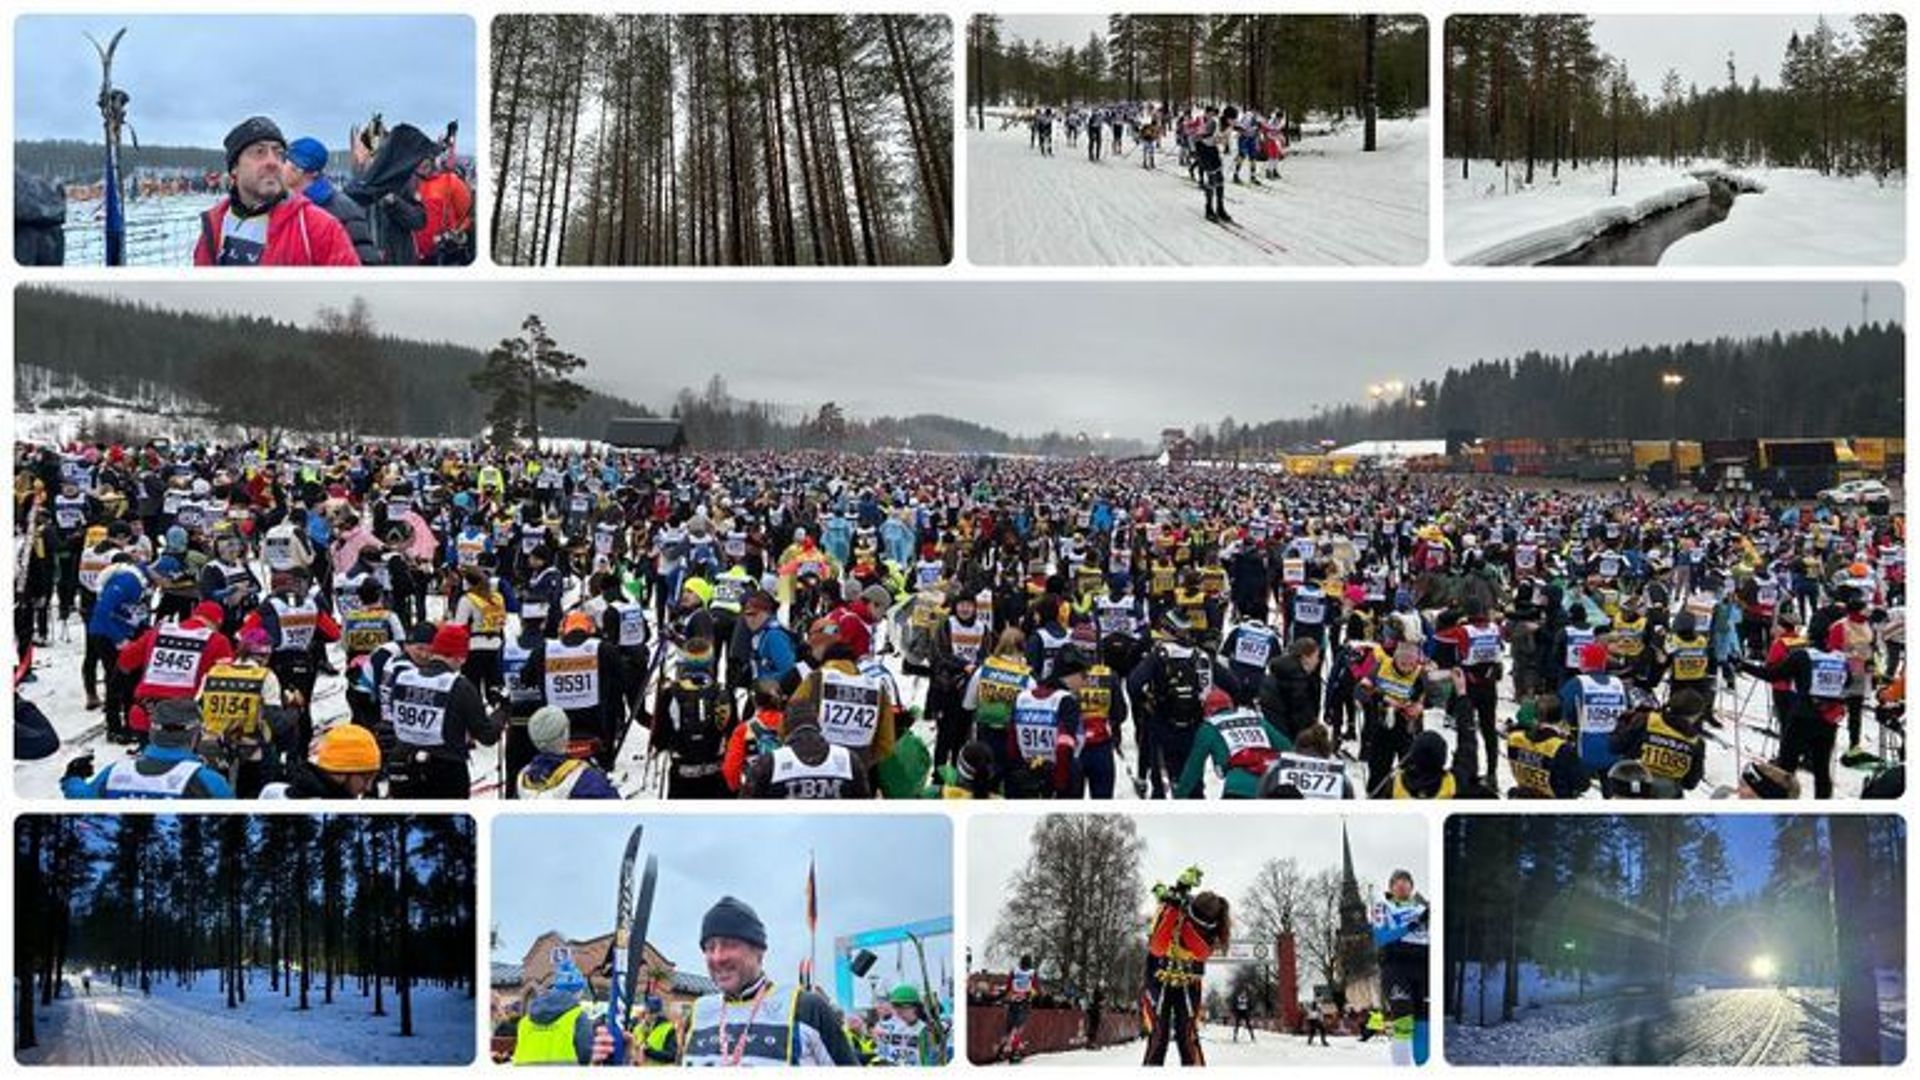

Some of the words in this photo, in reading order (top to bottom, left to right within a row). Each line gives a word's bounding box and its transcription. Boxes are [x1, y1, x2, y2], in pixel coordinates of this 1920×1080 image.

[154, 650, 194, 671] 9445
[552, 674, 592, 693] 9591
[397, 704, 437, 730] 9847
[824, 703, 876, 729] 12742
[1022, 726, 1055, 748] 9141
[785, 779, 843, 798] IBM
[1287, 770, 1337, 793] 9677
